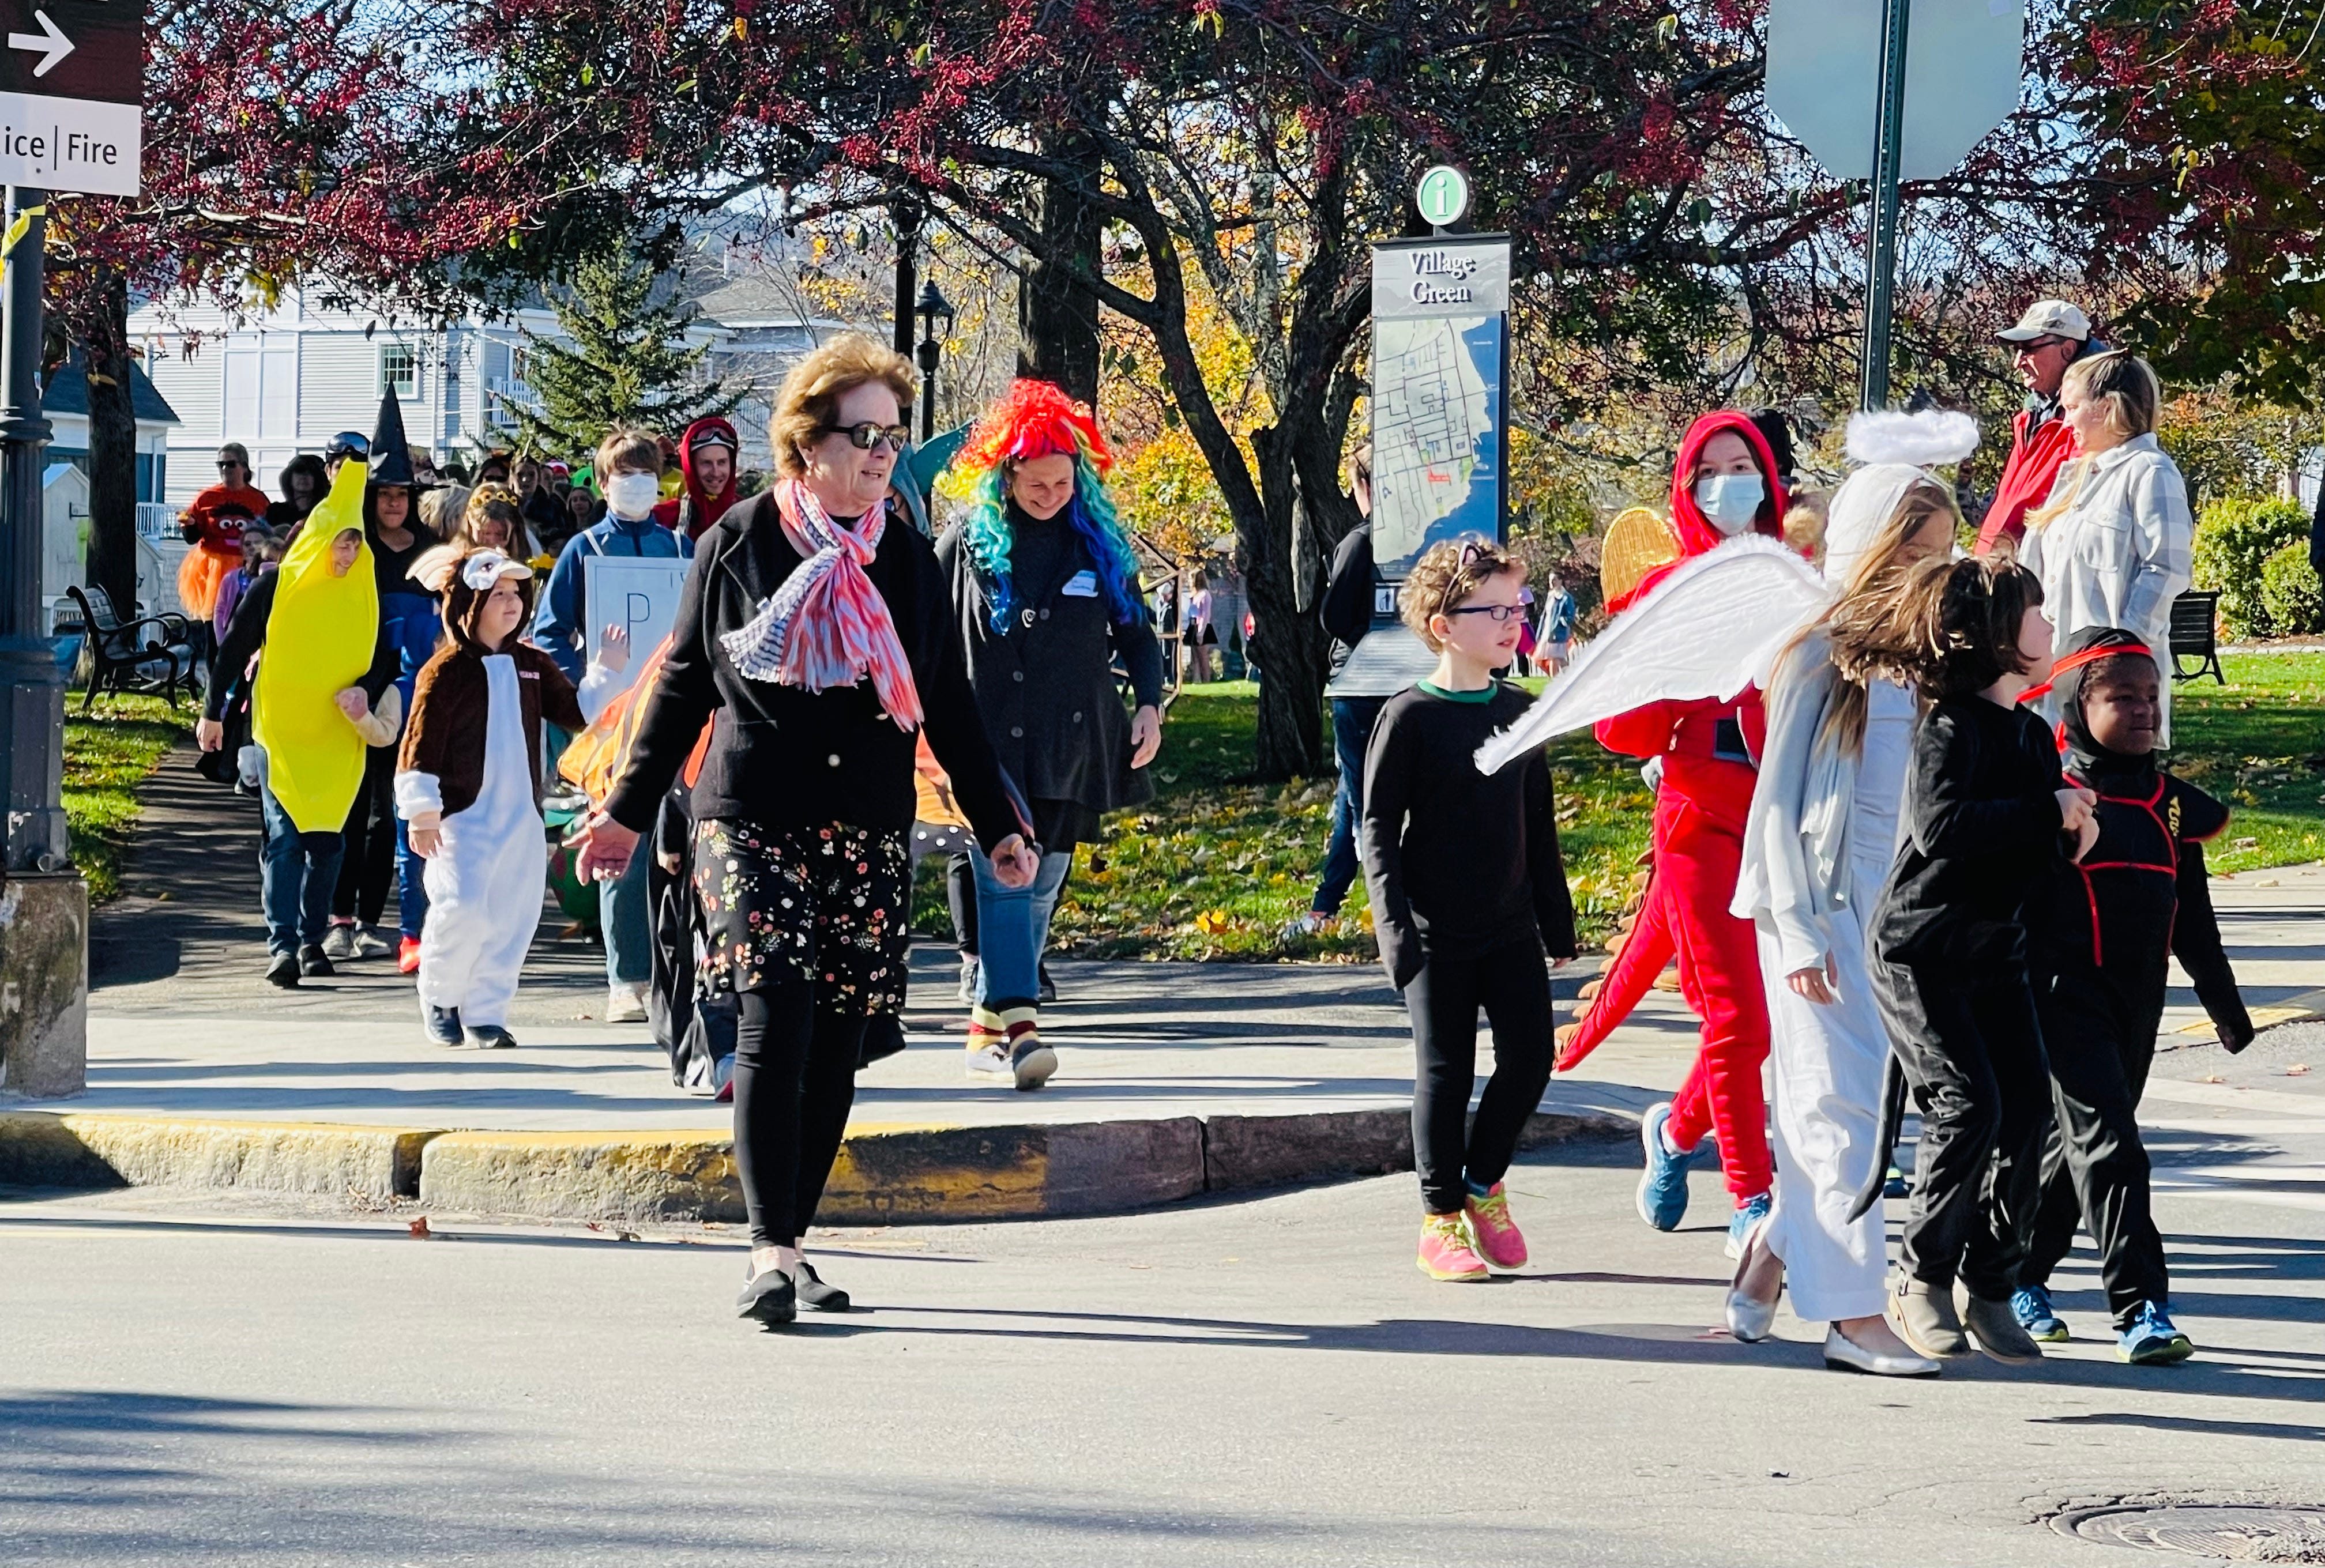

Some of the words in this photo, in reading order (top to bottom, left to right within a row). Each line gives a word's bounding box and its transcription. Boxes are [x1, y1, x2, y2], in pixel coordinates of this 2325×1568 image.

[0, 126, 45, 158] ice
[68, 133, 117, 165] Fire
[1407, 251, 1474, 280] Village
[1409, 280, 1469, 303] Green
[626, 592, 650, 660] P
